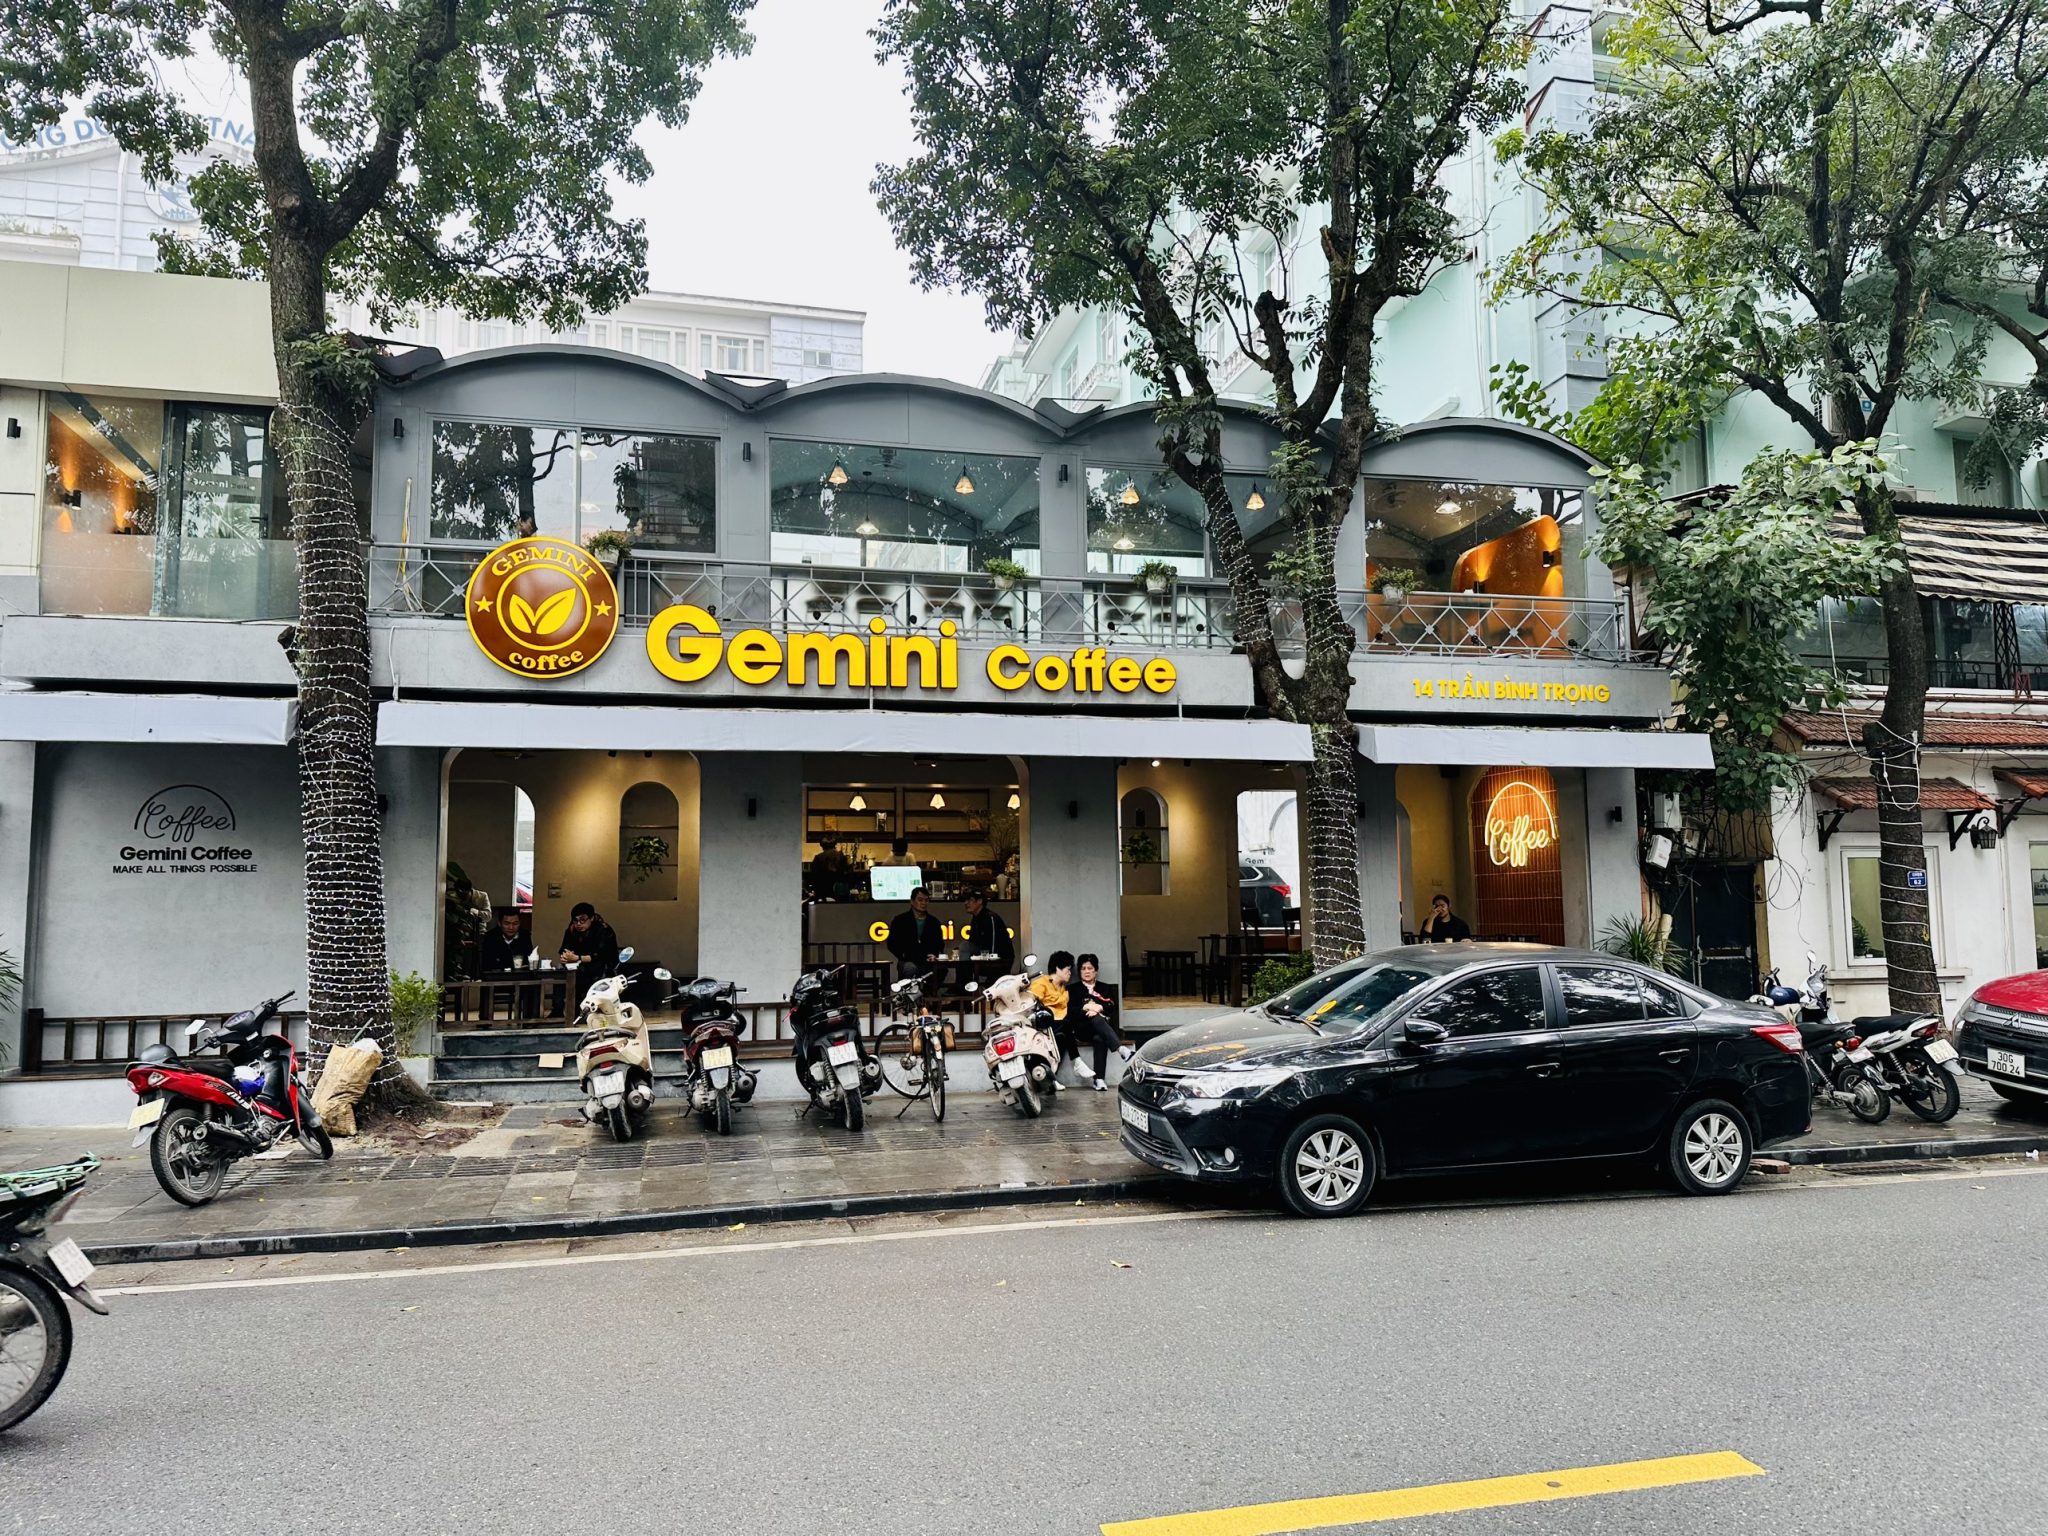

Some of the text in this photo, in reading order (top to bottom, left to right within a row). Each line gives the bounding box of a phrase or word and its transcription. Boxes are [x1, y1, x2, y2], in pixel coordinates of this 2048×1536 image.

[491, 546, 597, 582] GEMINI
[508, 650, 584, 671] coffee
[645, 603, 1177, 694] Gemini Coffee
[1413, 671, 1611, 706] 14 TRẦN BÌNH TRỌNG
[144, 801, 231, 843] Coffee
[120, 846, 253, 861] Gemini Coffee
[1489, 815, 1550, 868] Coffee
[112, 864, 258, 874] MAKE ALL THINGS POSSIBLE
[1997, 1051, 2014, 1063] 30G
